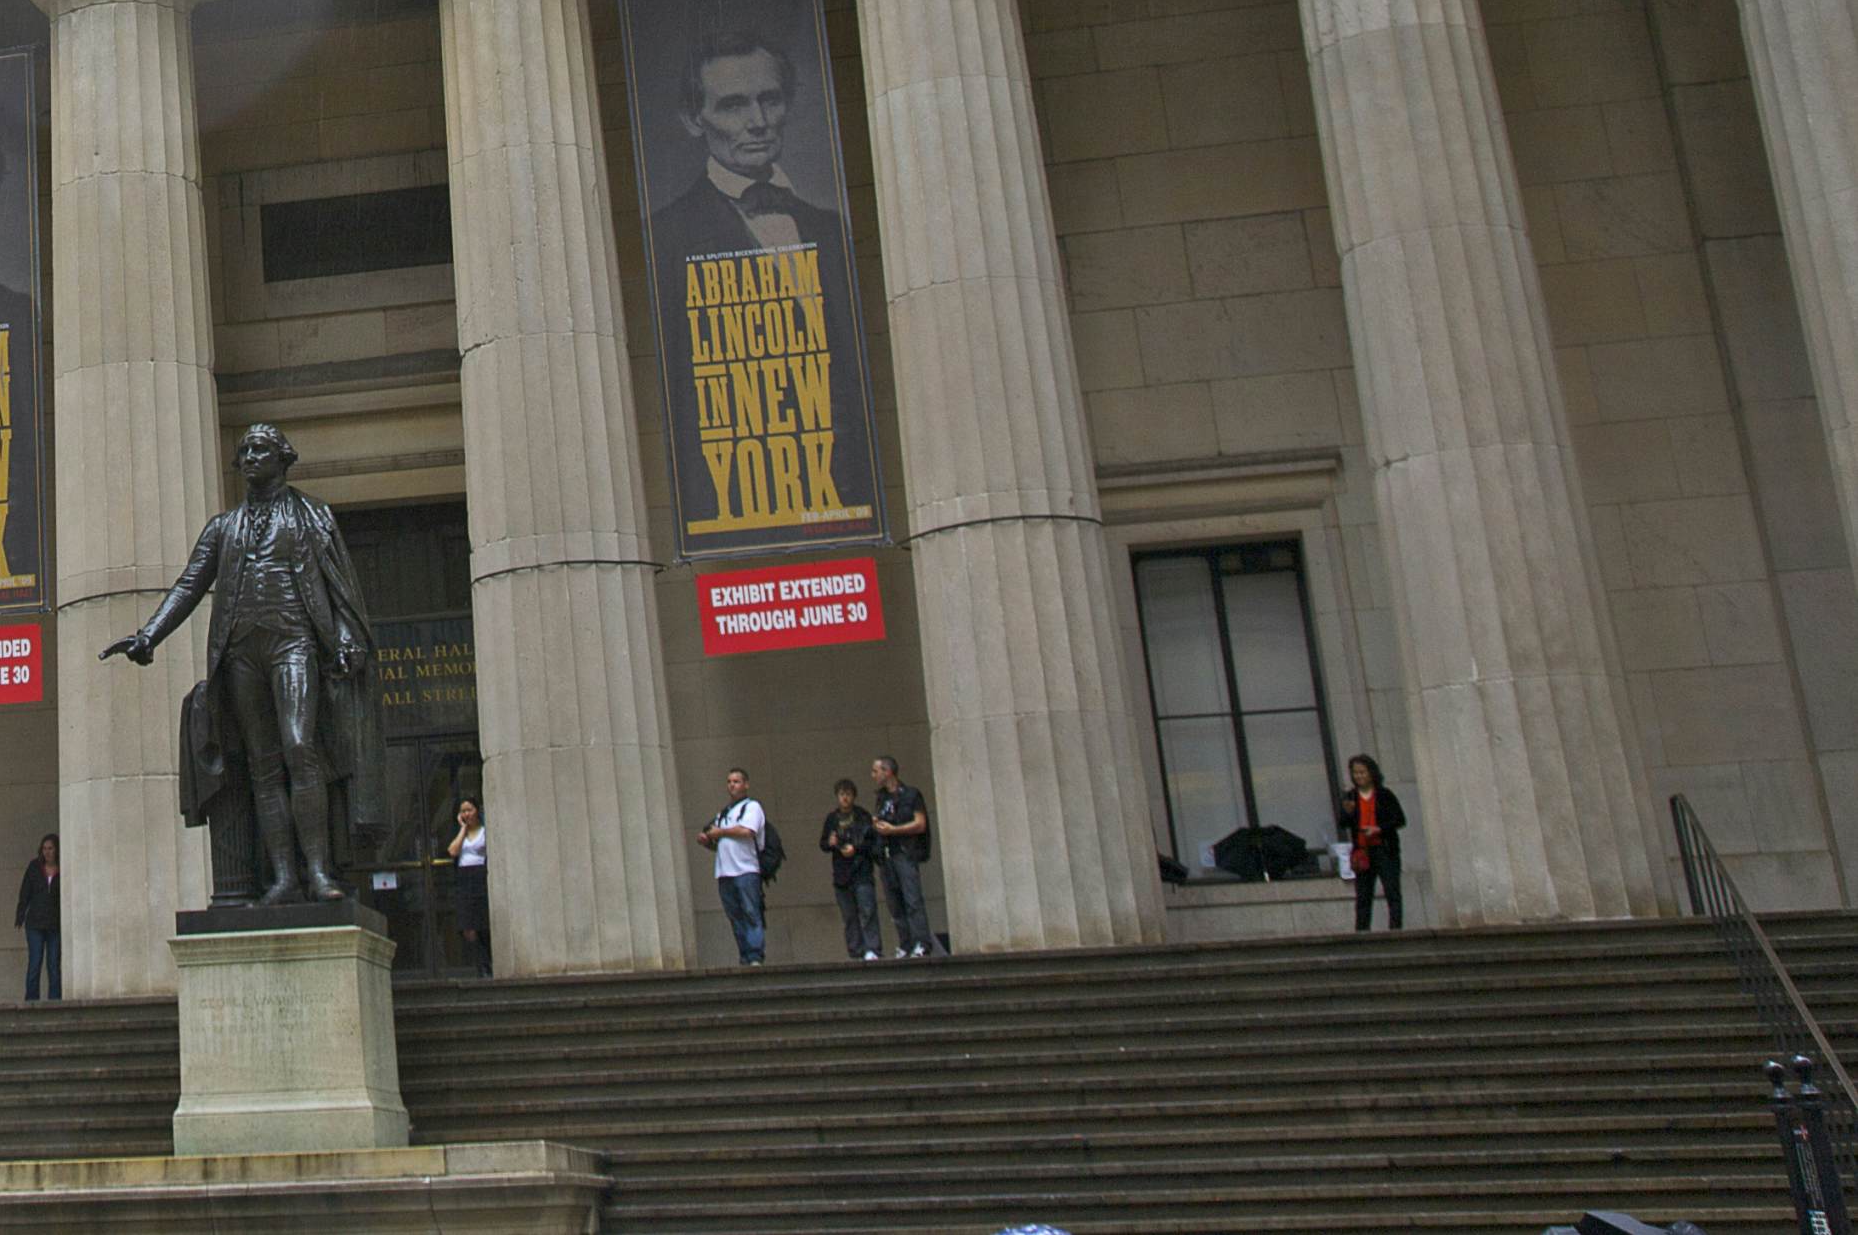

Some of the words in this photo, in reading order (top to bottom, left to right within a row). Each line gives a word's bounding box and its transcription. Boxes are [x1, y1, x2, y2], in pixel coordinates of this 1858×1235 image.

[686, 249, 822, 308] ABRAHAM
[687, 295, 828, 364] LINCOLN
[695, 376, 731, 429] IN
[729, 351, 831, 438] NEW
[702, 430, 844, 521] YORK
[710, 582, 775, 607] EXHIBIT
[779, 573, 866, 600] EXTENDED
[716, 609, 796, 635] THROUGH
[800, 604, 844, 627] JUNE
[847, 602, 868, 622] 30
[377, 646, 426, 662] ERAL
[434, 643, 473, 658] HAL
[13, 666, 30, 684] 30
[416, 661, 477, 678] MEMO
[382, 691, 415, 705] ALL
